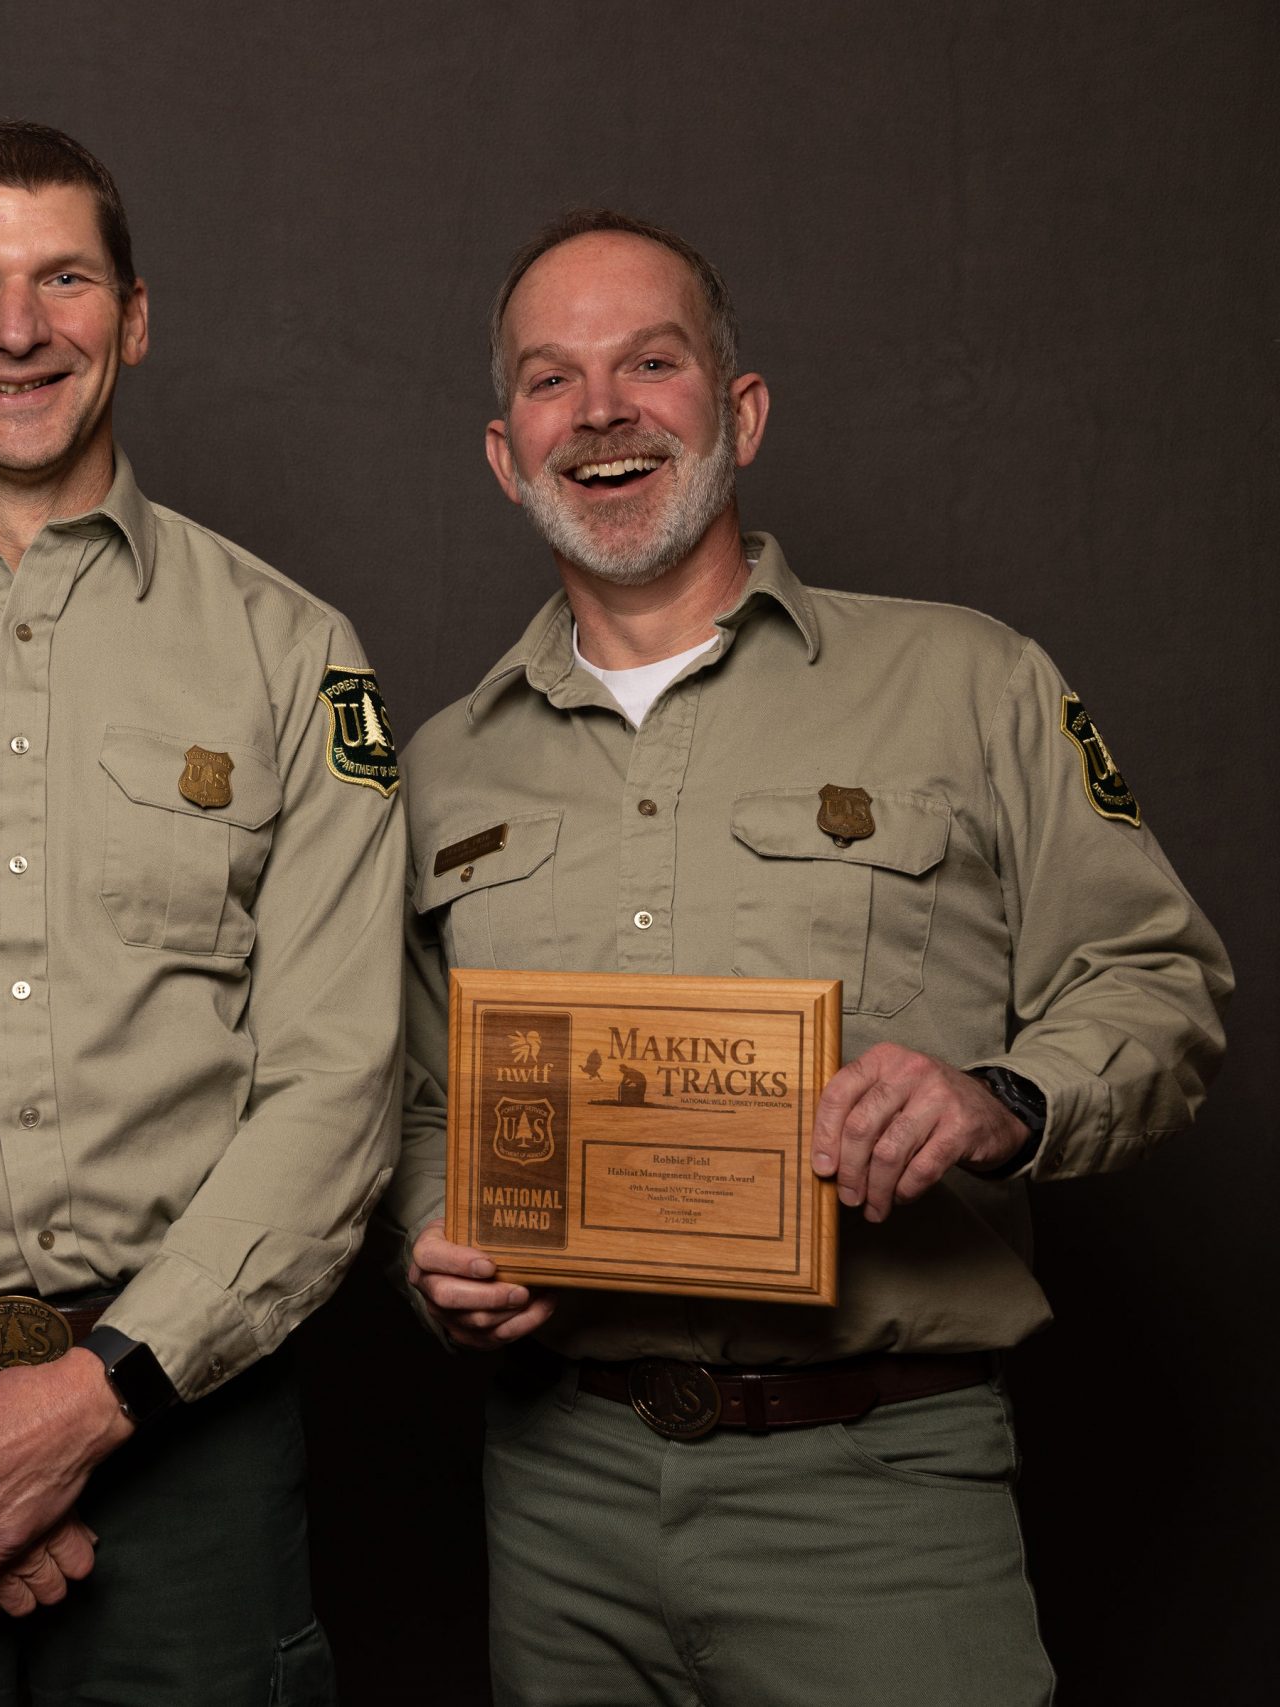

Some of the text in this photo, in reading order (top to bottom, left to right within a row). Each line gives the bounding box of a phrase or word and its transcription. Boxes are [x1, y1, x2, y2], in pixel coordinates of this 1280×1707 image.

[325, 679, 359, 698] FOREST
[333, 747, 379, 776] DEPARTMENT
[496, 1063, 554, 1083] nwtf
[656, 1066, 788, 1098] TRACKS
[753, 1101, 792, 1109] FEDERATION
[653, 1155, 684, 1164] Robbie
[607, 1167, 755, 1183] Habitat Management Program Award
[483, 1186, 562, 1209] NATIONAL
[644, 1185, 669, 1193] Annual
[669, 1186, 694, 1194] NWTF
[695, 1188, 734, 1197] Convention
[681, 1195, 715, 1204] Tennessee
[492, 1209, 550, 1230] AWARD
